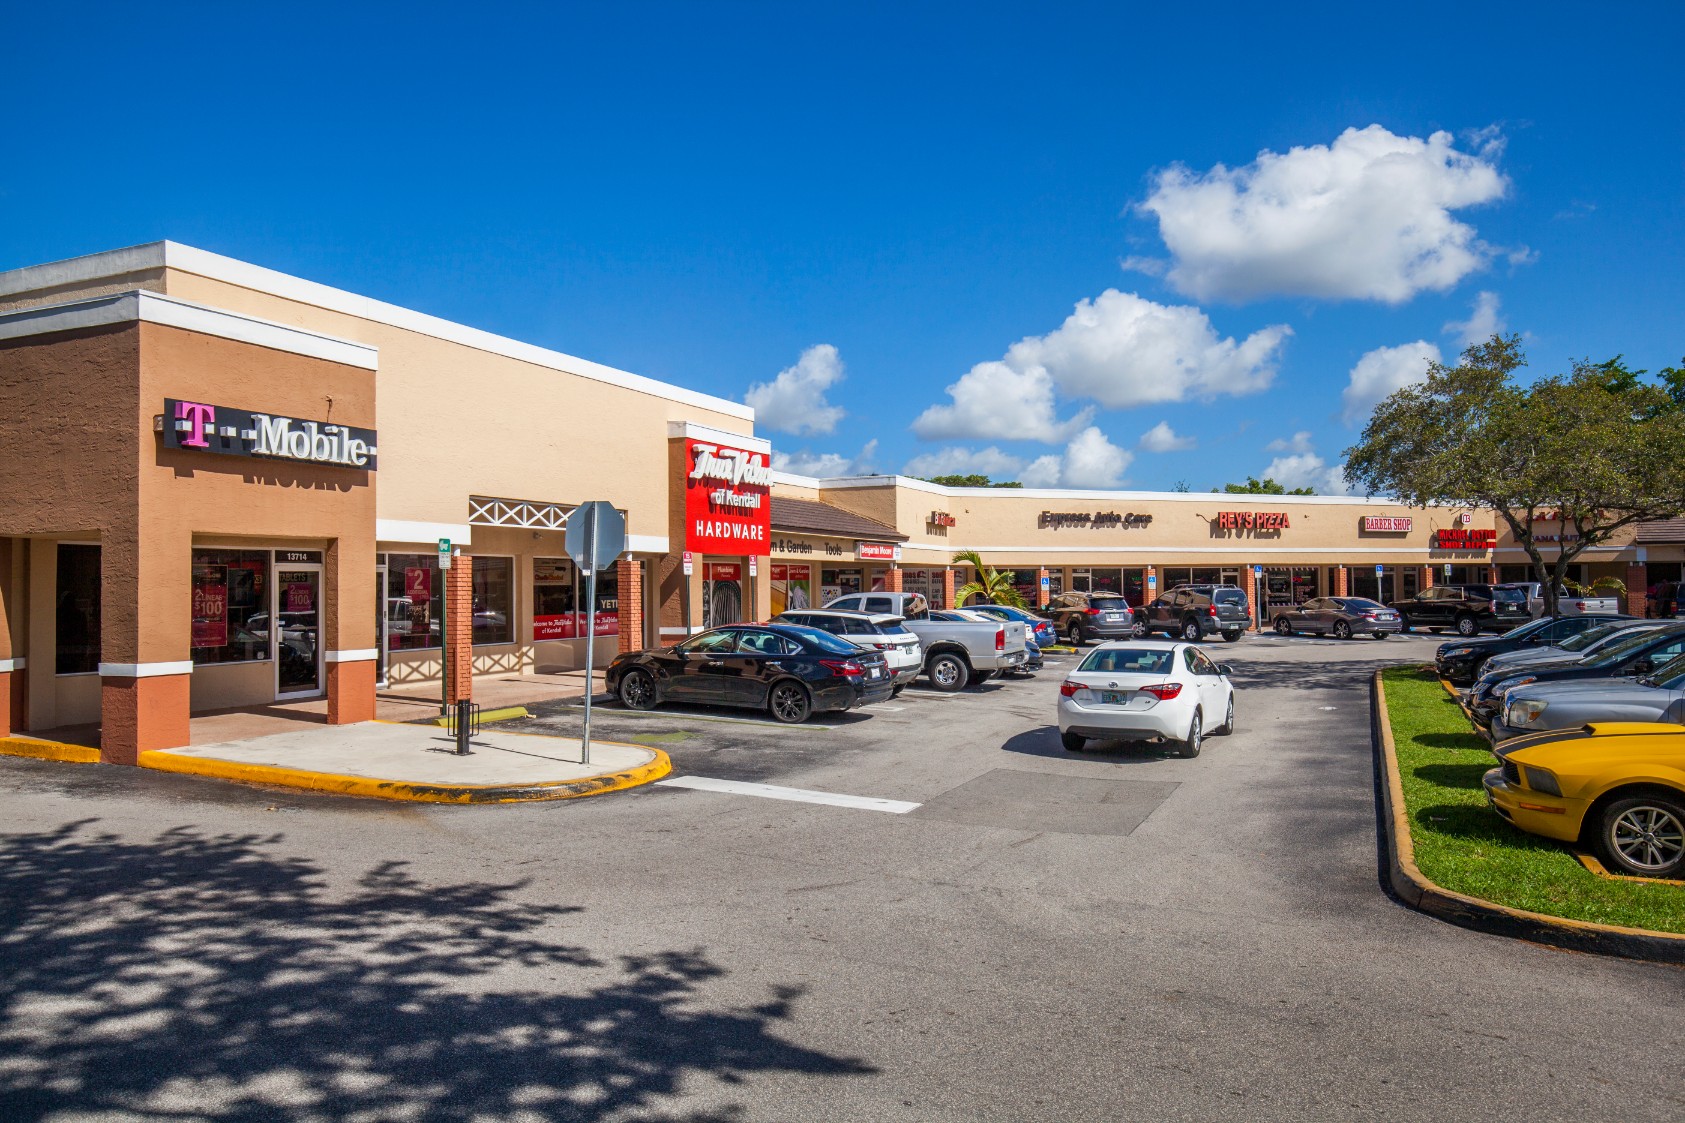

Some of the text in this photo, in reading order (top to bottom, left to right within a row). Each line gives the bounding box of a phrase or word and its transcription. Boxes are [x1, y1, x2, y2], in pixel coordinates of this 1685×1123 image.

[715, 489, 761, 509] of Kendall
[1218, 512, 1290, 528] REY'S PIZZA
[1365, 518, 1411, 531] BARBER SHOP
[696, 520, 763, 540] HARDWARE
[780, 540, 786, 553] &
[787, 539, 812, 554] Garden
[825, 542, 842, 556] Tools
[861, 544, 879, 556] Benjamin
[879, 546, 892, 555] Moore
[287, 552, 307, 561] 13714
[414, 569, 424, 589] 2
[195, 589, 202, 601] 2
[290, 585, 296, 594] 2
[194, 601, 223, 615] $100
[601, 600, 618, 608] YETI
